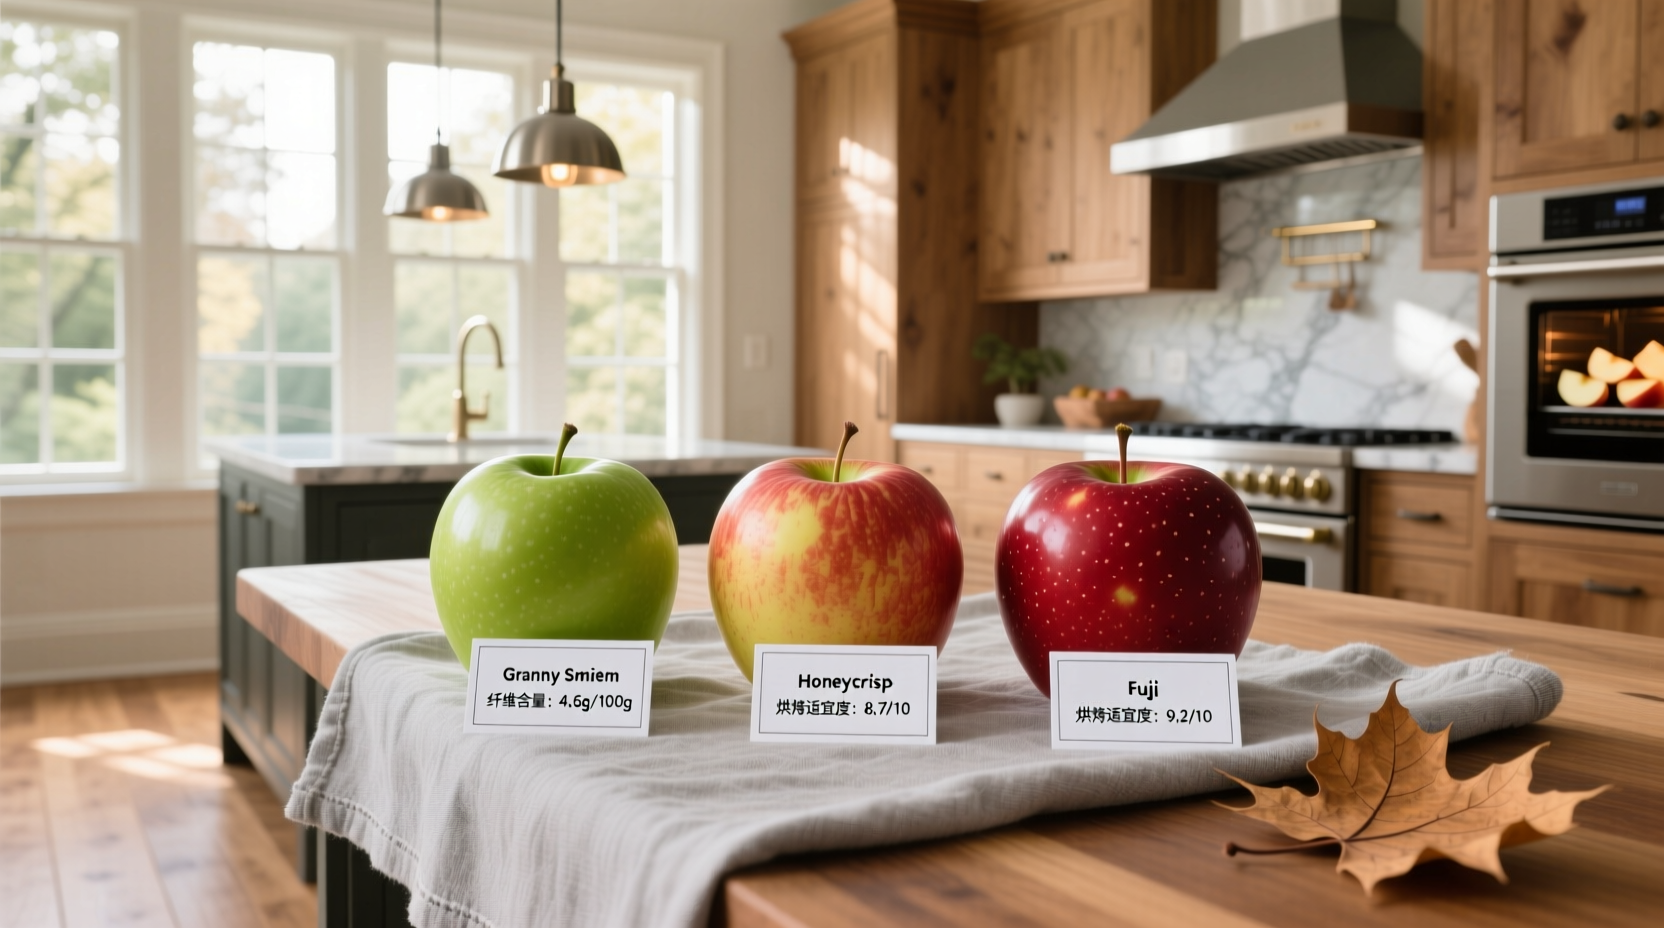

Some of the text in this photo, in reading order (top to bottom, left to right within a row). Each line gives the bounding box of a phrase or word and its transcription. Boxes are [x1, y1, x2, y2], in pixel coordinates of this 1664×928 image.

[503, 667, 619, 686] Granny Smiem
[798, 673, 893, 693] Honeycrisp
[1128, 679, 1159, 701] Fuji
